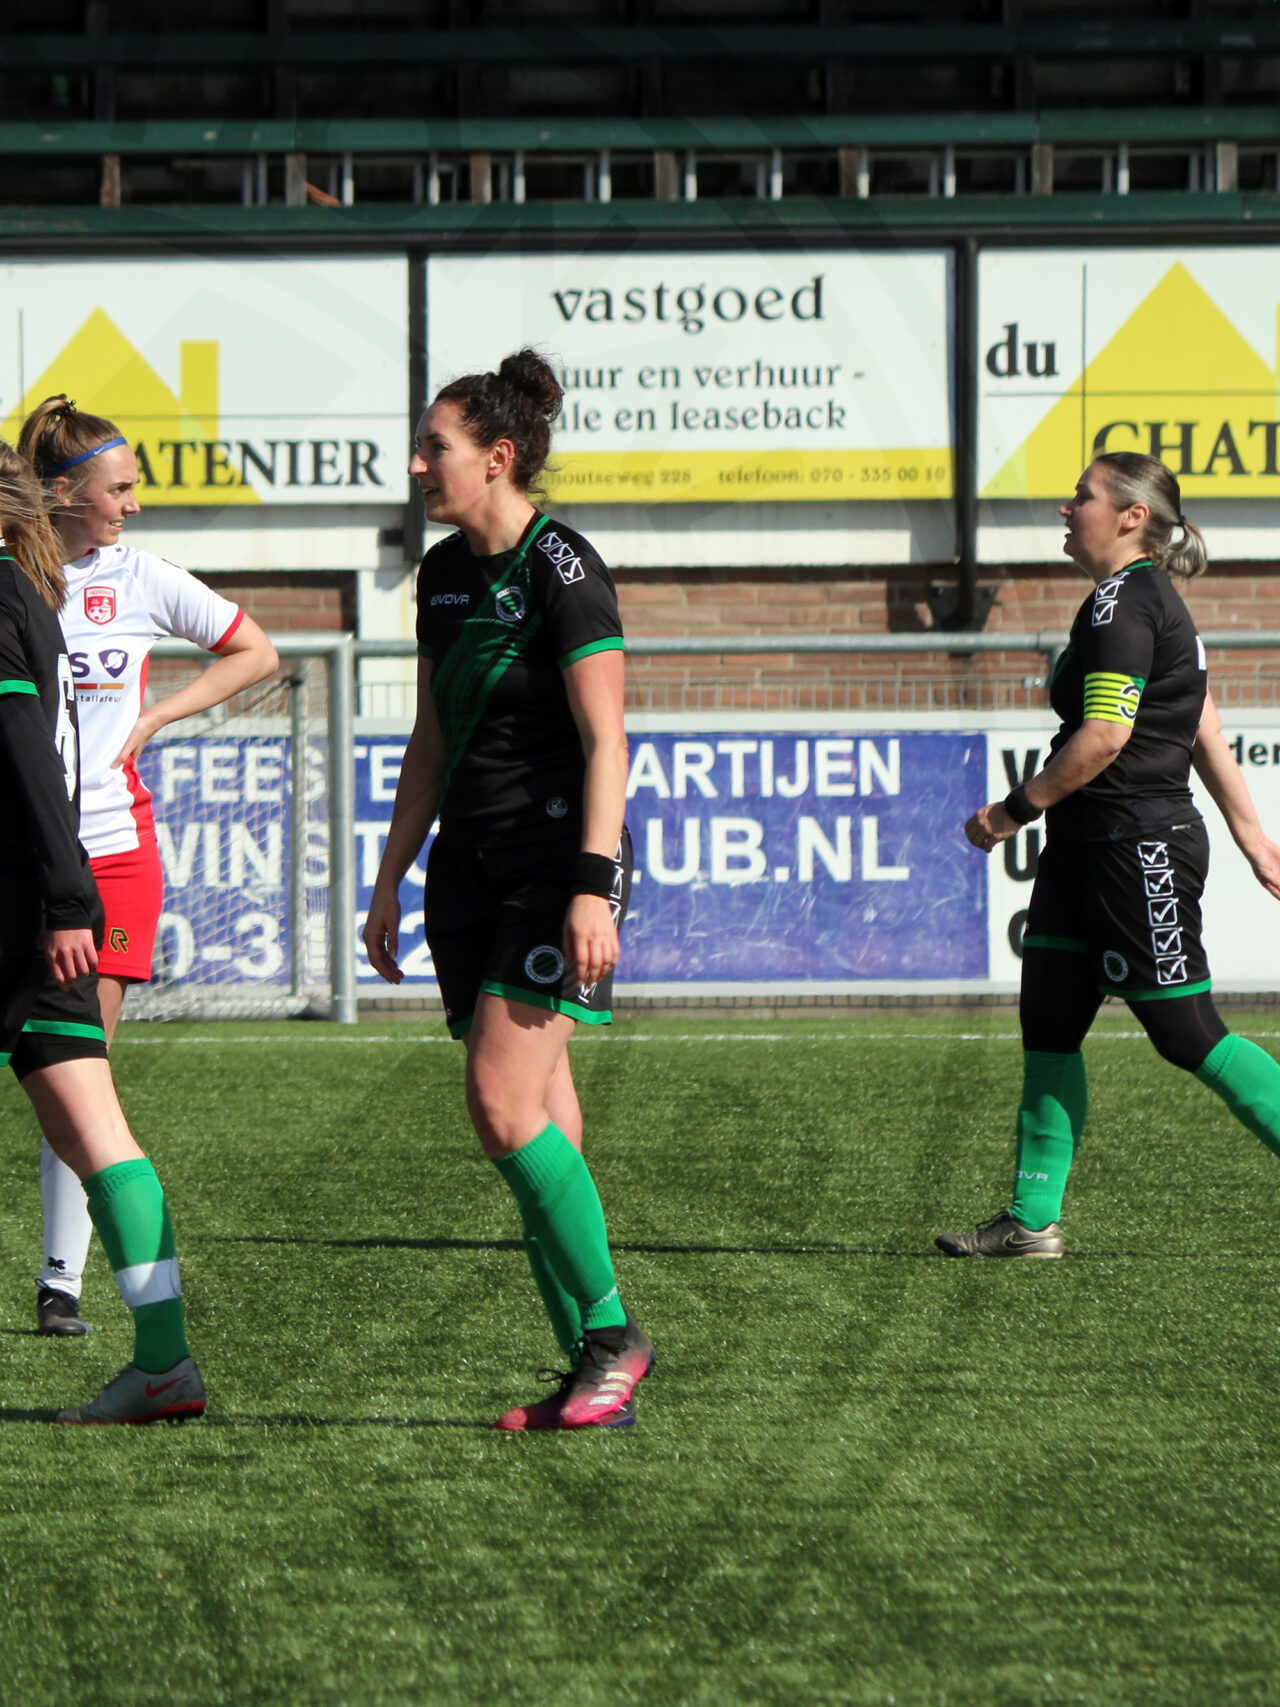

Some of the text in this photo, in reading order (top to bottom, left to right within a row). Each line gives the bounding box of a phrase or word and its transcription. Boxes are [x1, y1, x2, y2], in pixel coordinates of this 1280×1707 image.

[552, 274, 825, 334] vastgoed
[986, 322, 1059, 378] du
[560, 364, 623, 390] uur
[637, 364, 681, 389] en
[693, 358, 843, 389] verhuur
[555, 399, 847, 431] ale en leaseback
[137, 440, 385, 488] ATENIER
[809, 467, 843, 483] 070
[70, 651, 91, 679] S
[627, 738, 902, 799] ARTIJEN
